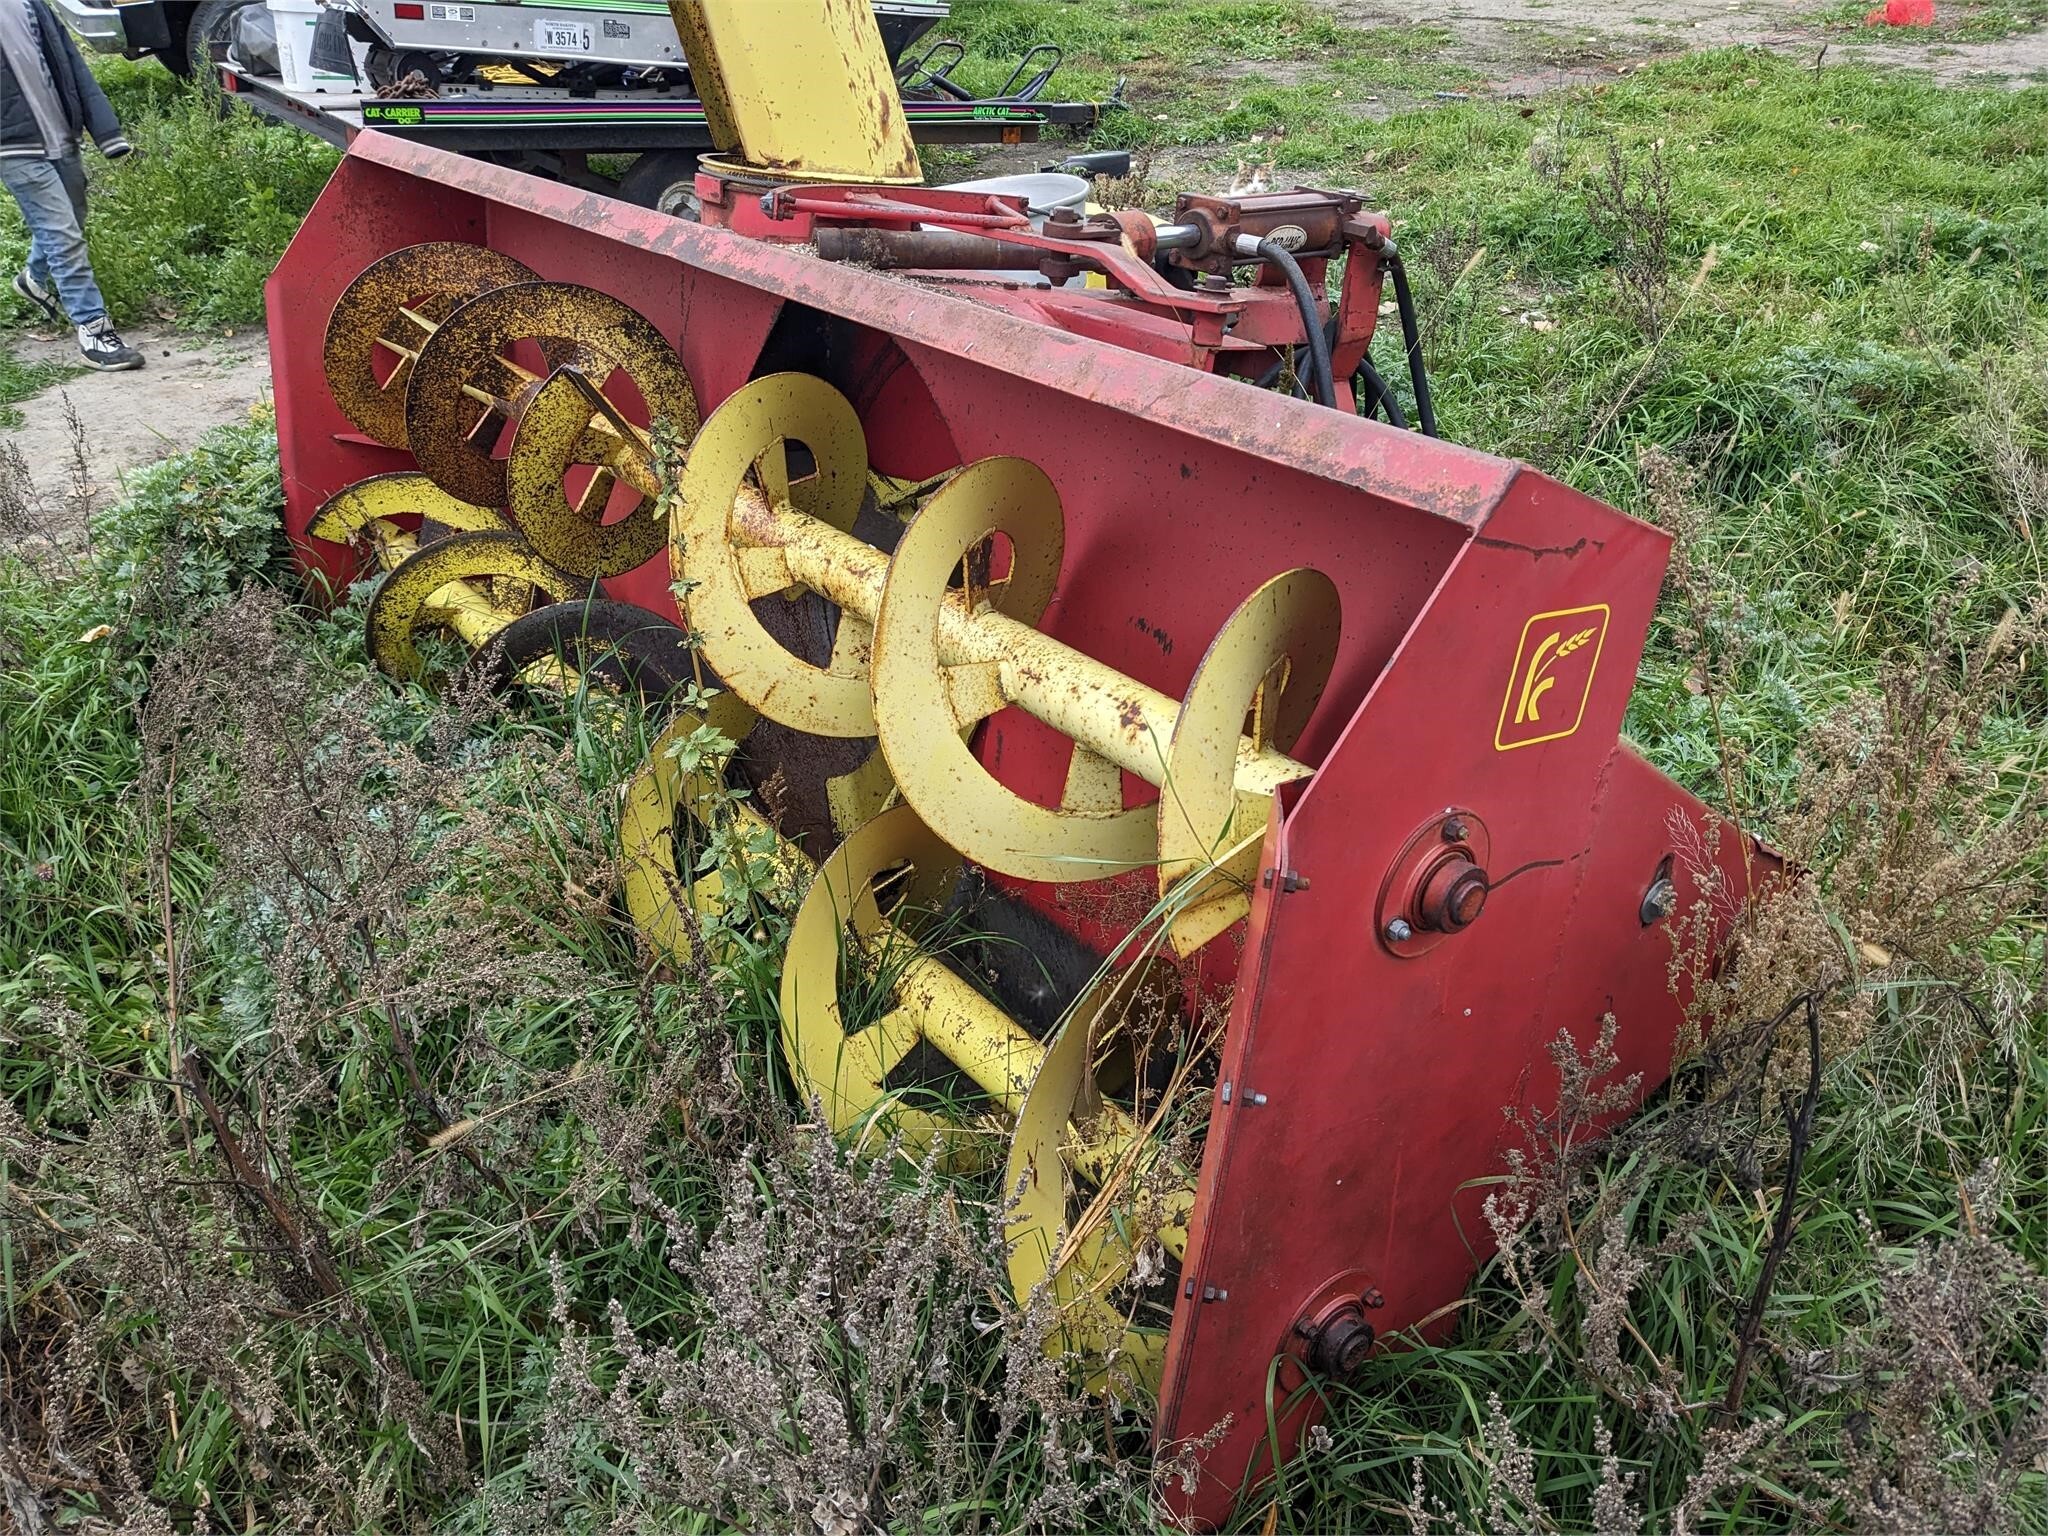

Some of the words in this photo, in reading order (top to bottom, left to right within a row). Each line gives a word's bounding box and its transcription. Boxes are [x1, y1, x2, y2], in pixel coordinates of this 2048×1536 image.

[555, 31, 577, 46] 3574
[583, 28, 590, 50] 5
[365, 107, 381, 118] CAT
[385, 107, 421, 117] CARRIER
[973, 106, 996, 116] ARCTIC
[997, 107, 1010, 116] CAT
